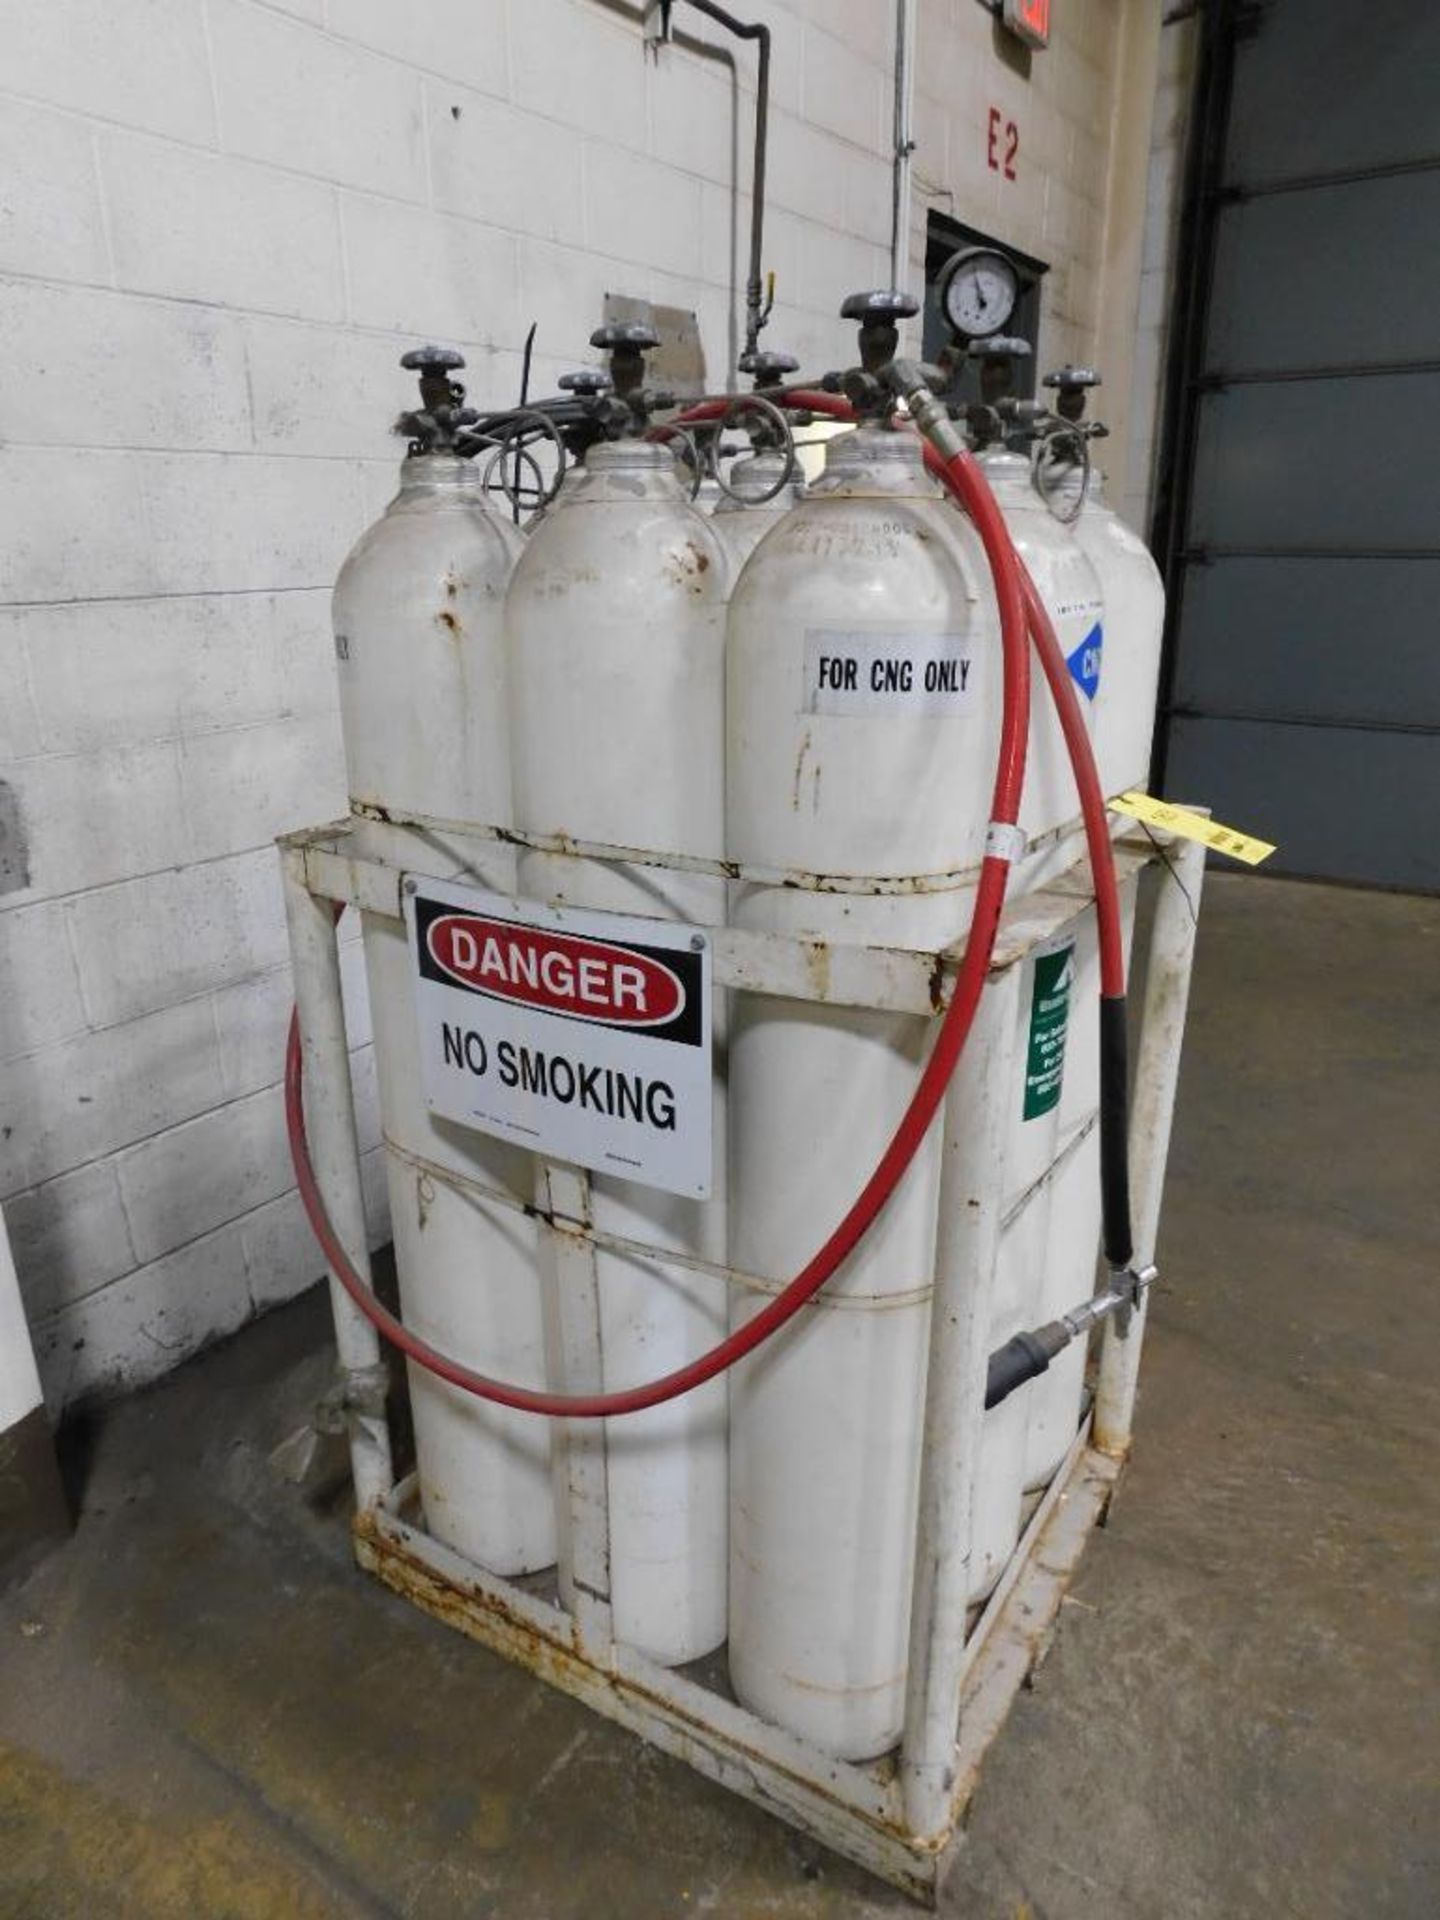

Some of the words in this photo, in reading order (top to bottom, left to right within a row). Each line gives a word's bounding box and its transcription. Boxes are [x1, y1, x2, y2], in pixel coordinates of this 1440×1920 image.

[988, 106, 1019, 182] E2
[818, 656, 858, 691] FOR
[871, 659, 913, 692] CNG
[924, 659, 972, 692] ONLY
[450, 927, 649, 1012] DANGER
[441, 1022, 488, 1077] NO
[497, 1040, 677, 1131] SMOKING
